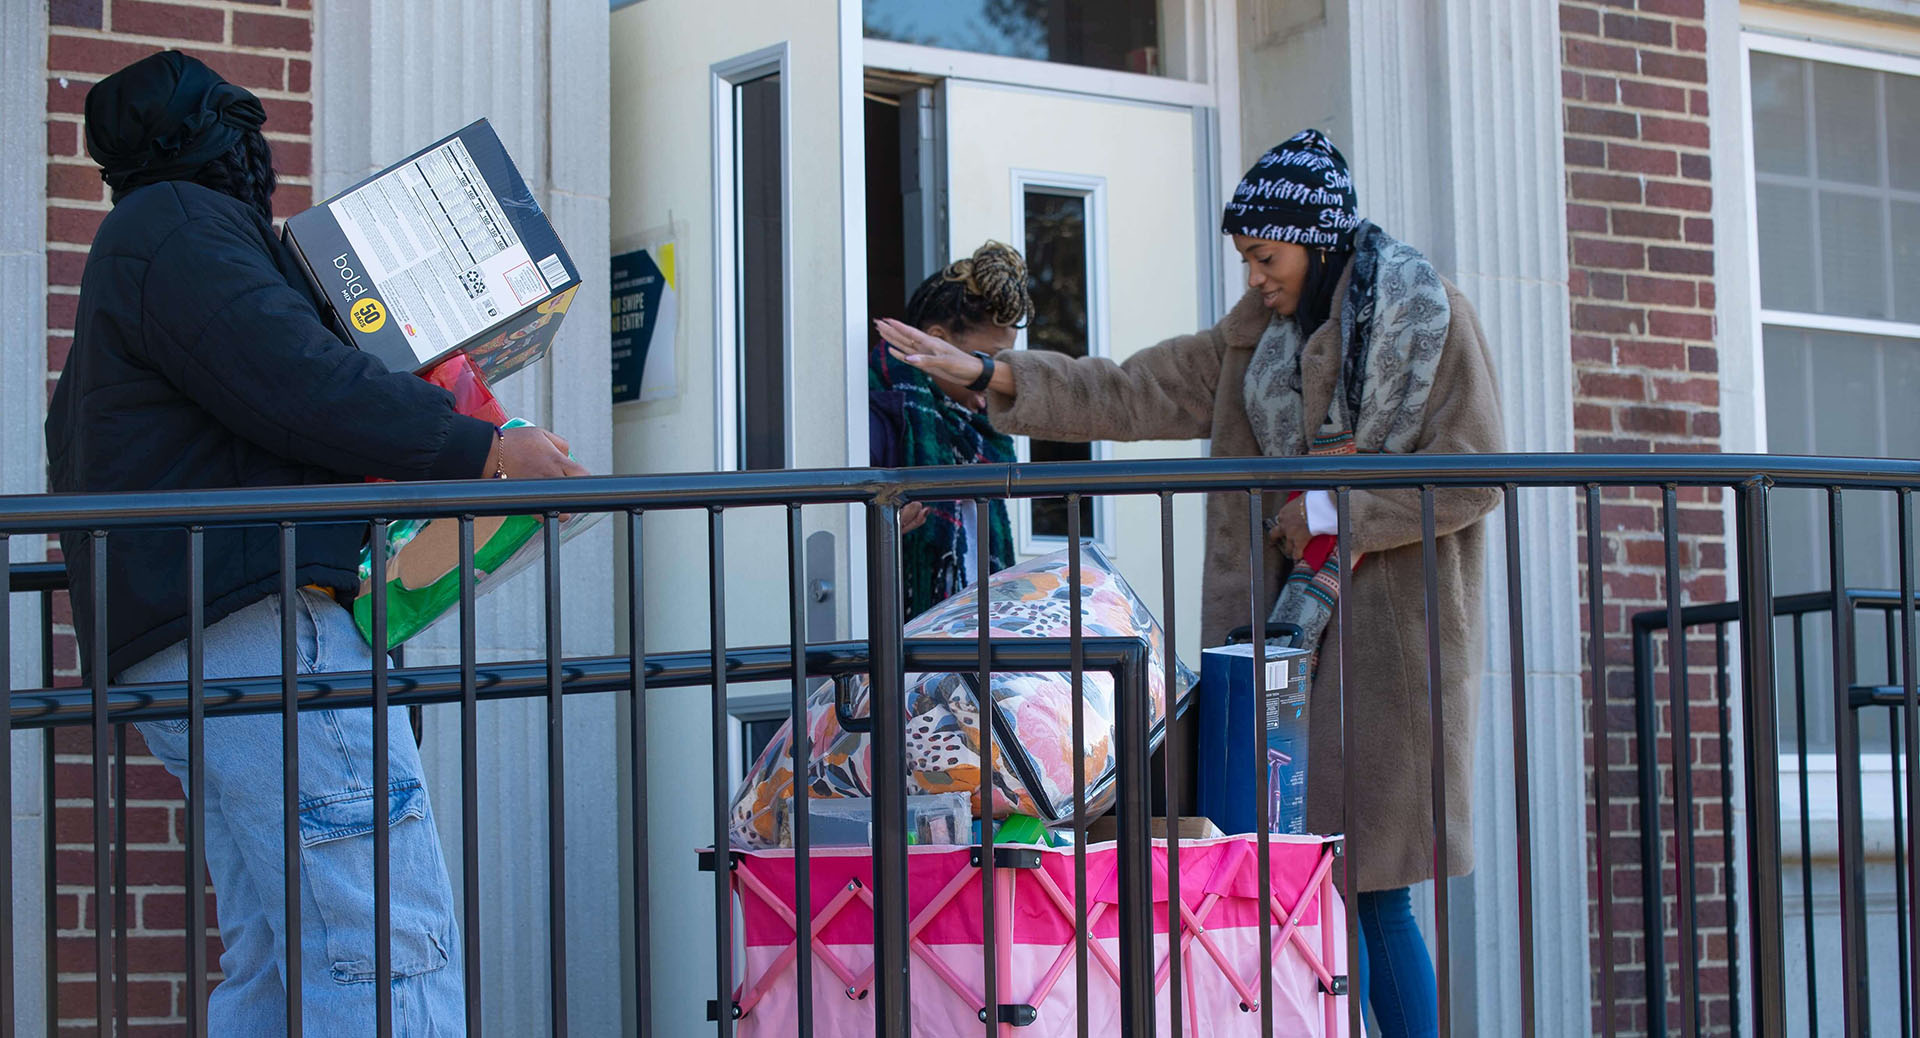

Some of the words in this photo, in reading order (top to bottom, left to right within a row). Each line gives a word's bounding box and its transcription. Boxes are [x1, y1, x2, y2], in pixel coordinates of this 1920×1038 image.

[333, 253, 368, 299] bold
[341, 289, 353, 303] MIX
[622, 292, 645, 312] SWIPE
[353, 311, 366, 328] BAGS
[360, 303, 381, 324] 50
[622, 311, 645, 331] ENTRY
